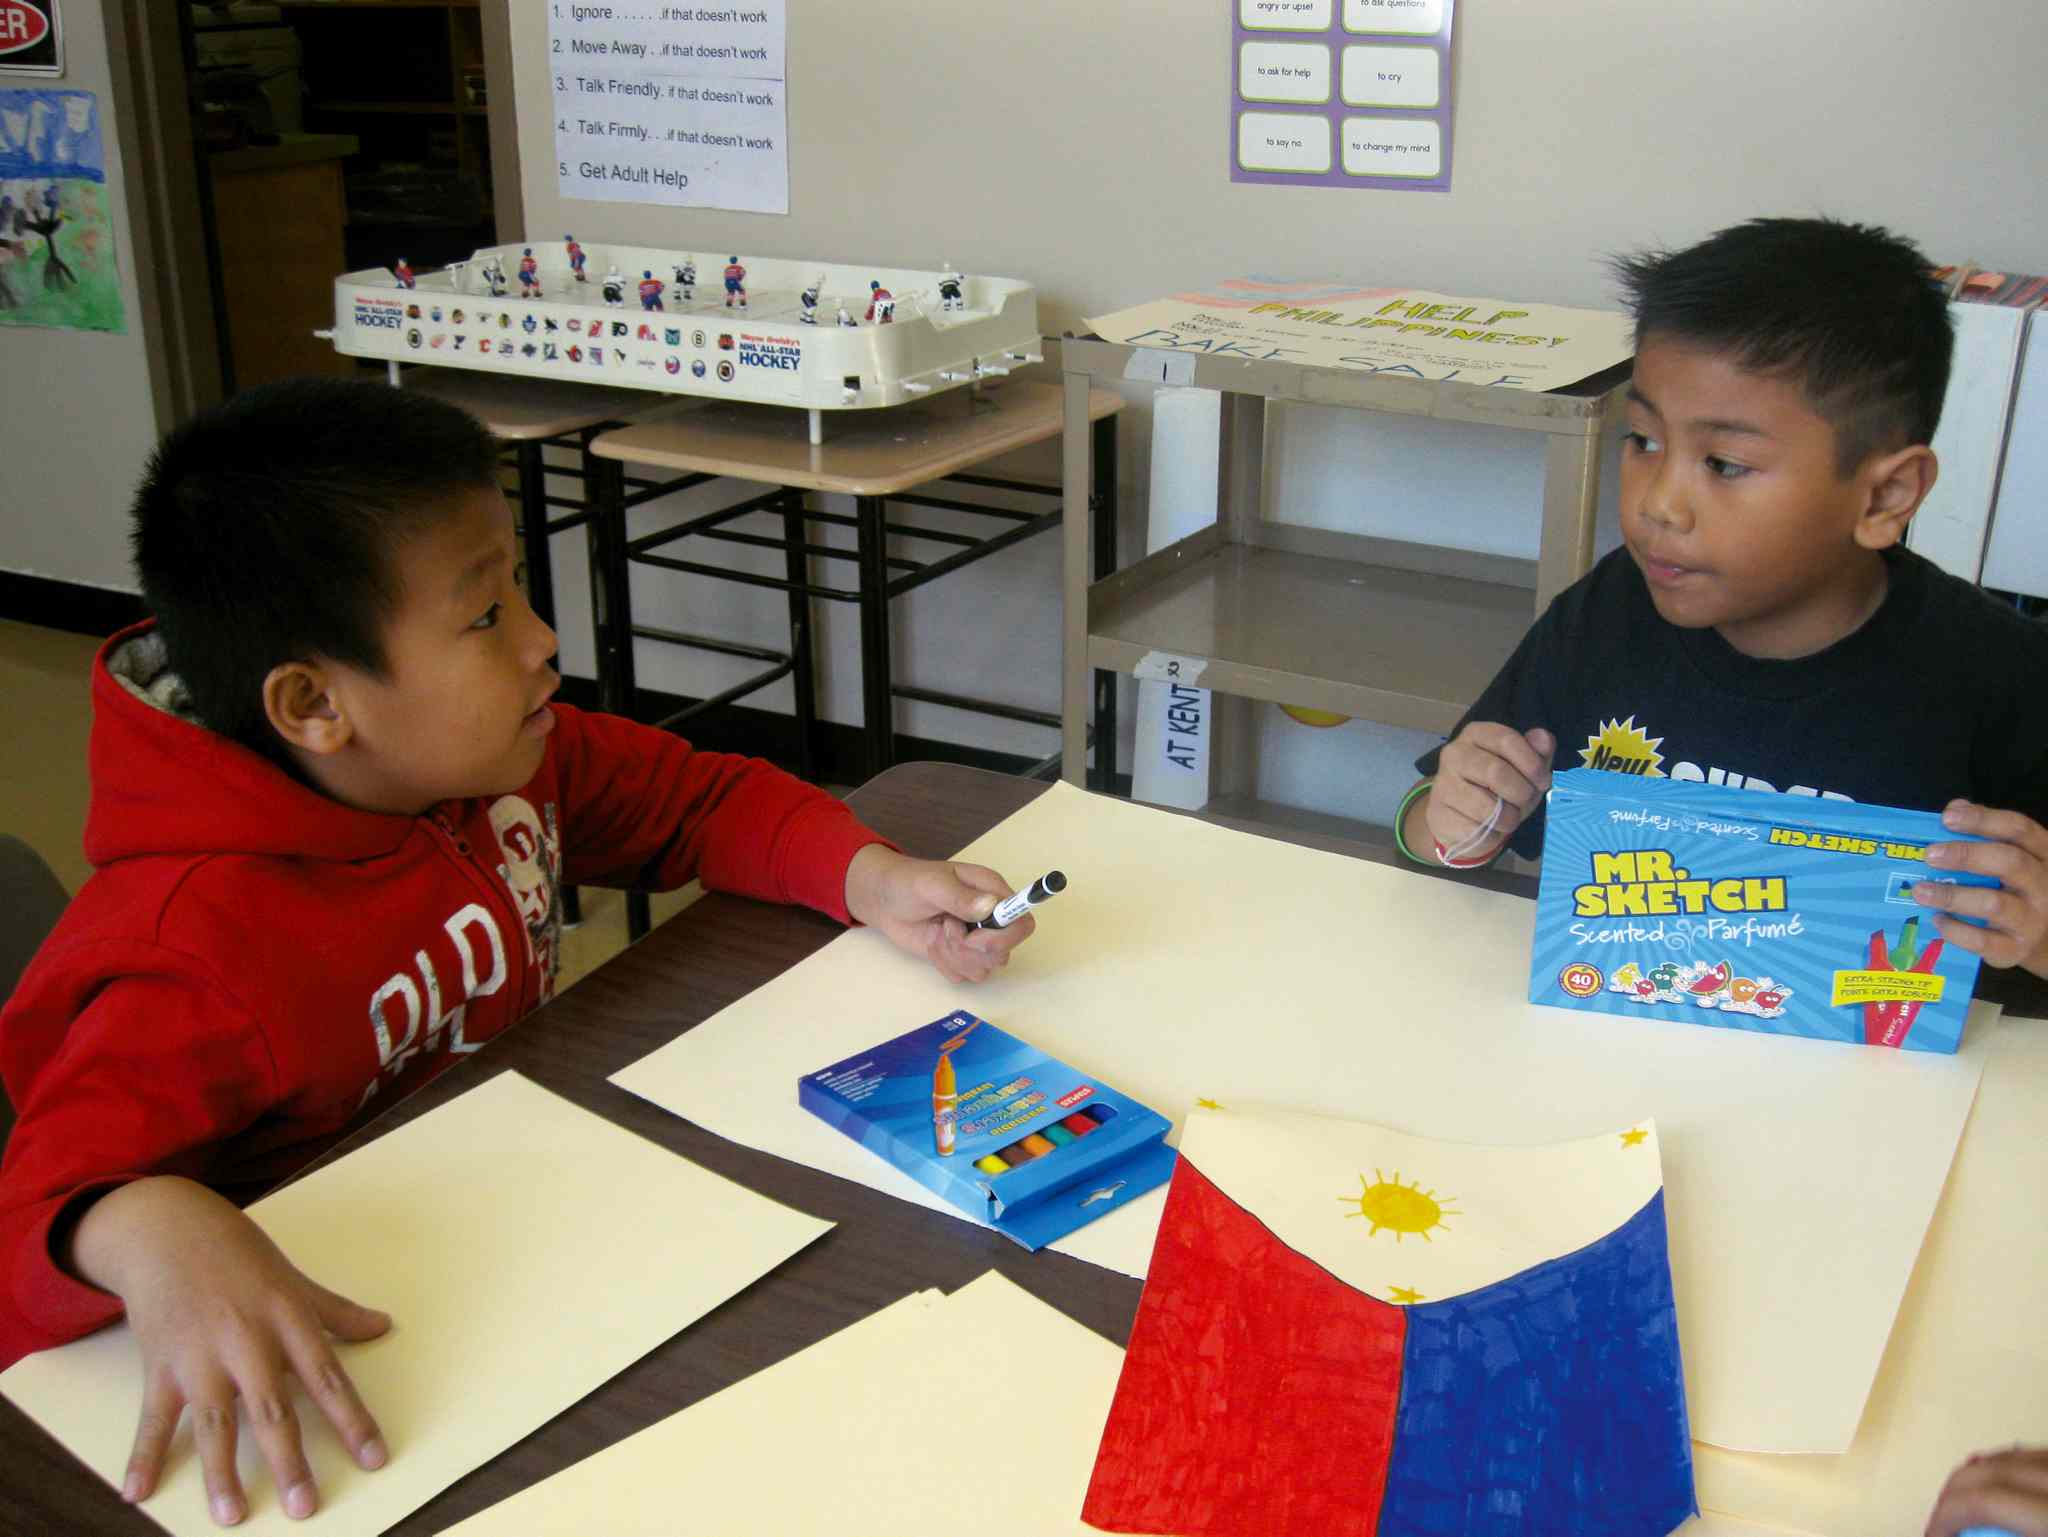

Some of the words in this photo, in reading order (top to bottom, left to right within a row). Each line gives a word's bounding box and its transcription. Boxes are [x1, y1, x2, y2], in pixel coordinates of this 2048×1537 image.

[571, 5, 613, 22] Ignore
[672, 9, 693, 21] that
[695, 10, 737, 22] doesn't
[740, 11, 768, 23] work
[1256, 3, 1279, 12] angry
[1293, 3, 1313, 13] upset
[571, 40, 607, 55] Move
[611, 41, 647, 58] Away
[672, 44, 694, 57] that
[696, 45, 737, 59] doesn't
[739, 48, 767, 60] work
[1257, 67, 1266, 76] to
[1267, 67, 1279, 76] ask
[1281, 67, 1292, 77] for
[1294, 68, 1311, 79] help
[1377, 72, 1386, 81] to
[1388, 74, 1402, 84] cry
[577, 78, 604, 93] Talk
[678, 87, 699, 100] that
[702, 88, 744, 104] doesn't
[746, 93, 773, 106] work
[578, 120, 605, 136] Talk
[677, 129, 699, 144] that
[701, 131, 743, 147] doesn't
[746, 137, 773, 151] work
[1266, 138, 1274, 146] to
[1276, 139, 1289, 148] say
[1352, 142, 1361, 151] to
[1363, 142, 1394, 154] change
[1395, 144, 1408, 154] my
[1410, 145, 1430, 153] mind
[579, 162, 607, 179] Get
[611, 165, 649, 184] Adult
[653, 168, 688, 190] Help
[355, 314, 402, 329] HOCKEY
[1374, 299, 1530, 327] HELP
[760, 345, 800, 356] ALL-STAR
[740, 352, 800, 371] HOCKEY
[1168, 682, 1201, 736] KENT
[1167, 738, 1196, 770] AT
[1696, 819, 1760, 841] Scented
[1768, 827, 1878, 856] SKETCH
[1591, 848, 1691, 885] MR.
[1572, 874, 1790, 918] SKETCH
[1569, 920, 1666, 946] Scented
[1707, 914, 1806, 948] Parfumé
[1570, 973, 1592, 986] 40
